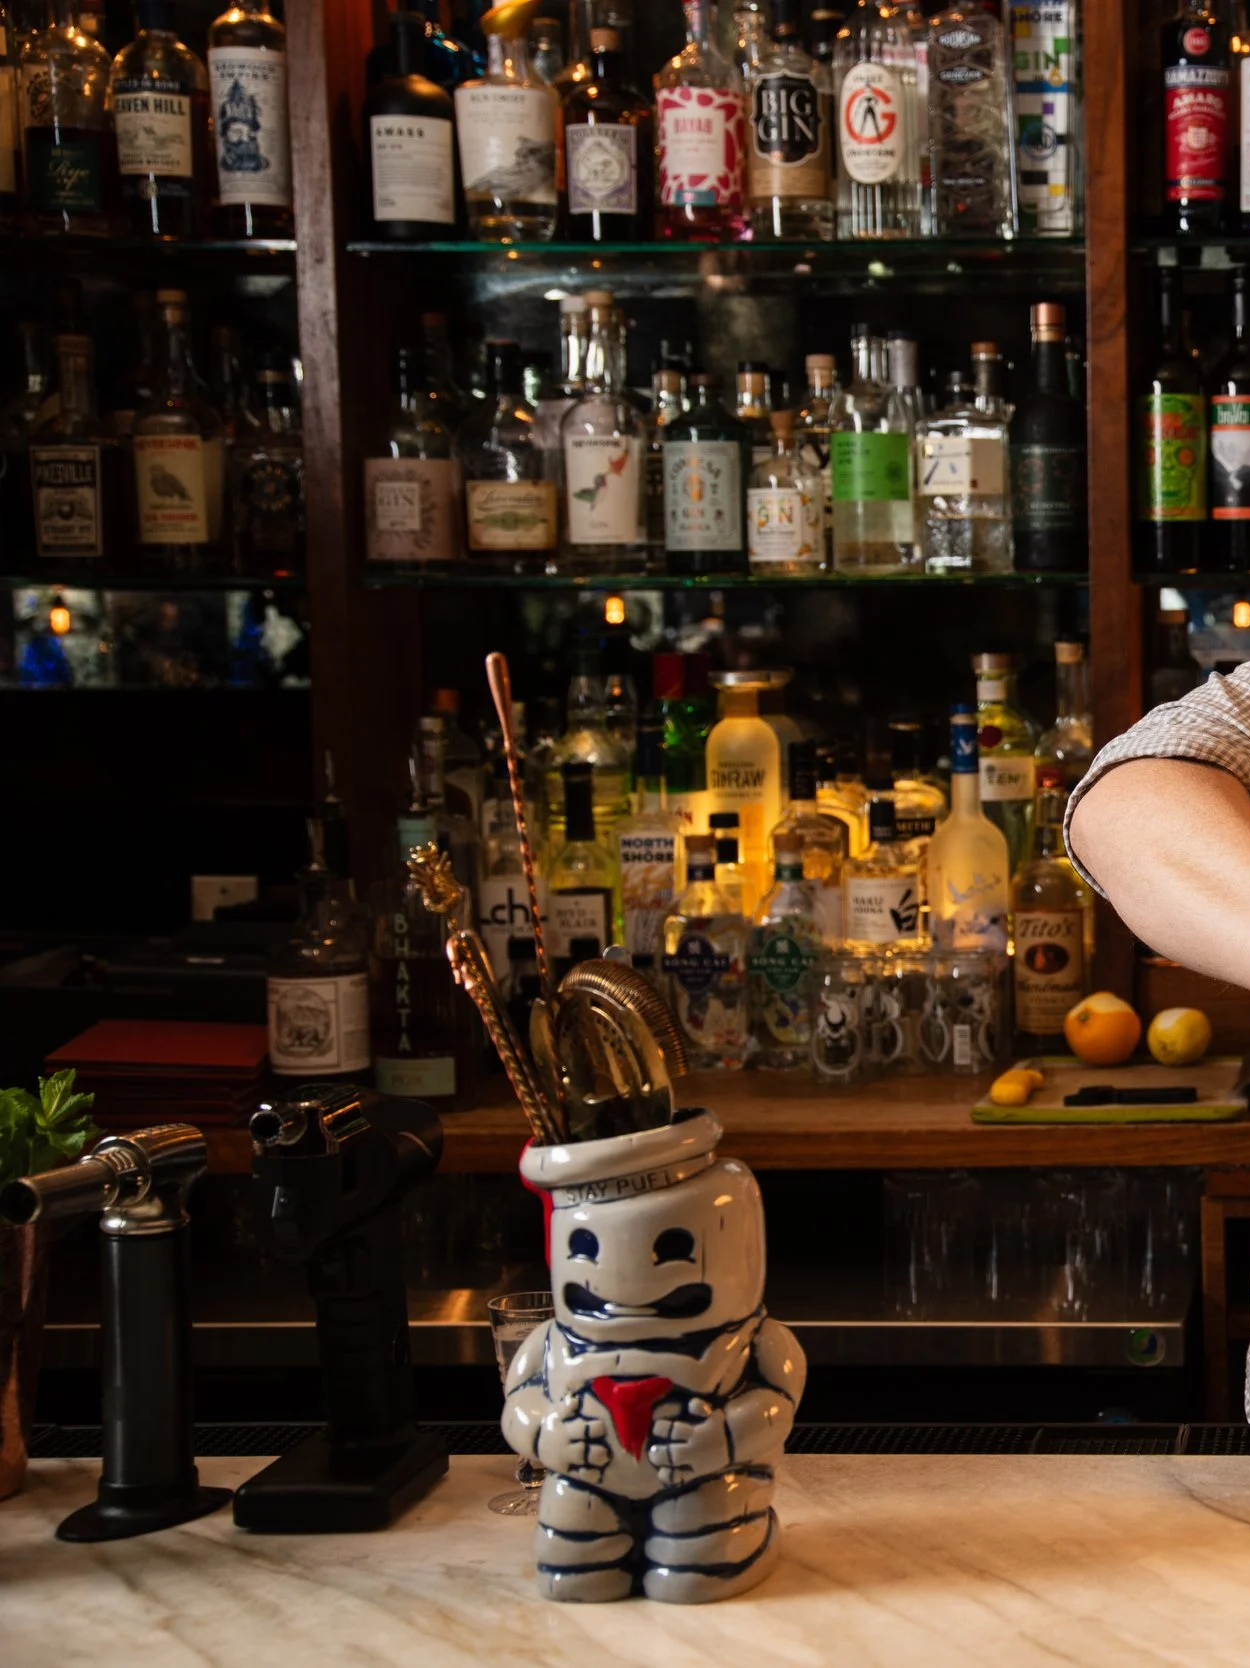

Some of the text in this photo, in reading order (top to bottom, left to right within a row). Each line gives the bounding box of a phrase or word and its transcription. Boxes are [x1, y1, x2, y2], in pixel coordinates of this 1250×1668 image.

[1013, 52, 1060, 69] GIN
[154, 98, 186, 116] HILL
[760, 88, 811, 116] BIG
[758, 115, 815, 142] GIN
[621, 837, 674, 848] NORTH
[1020, 916, 1073, 938] Tito's
[566, 1180, 607, 1202] STAY
